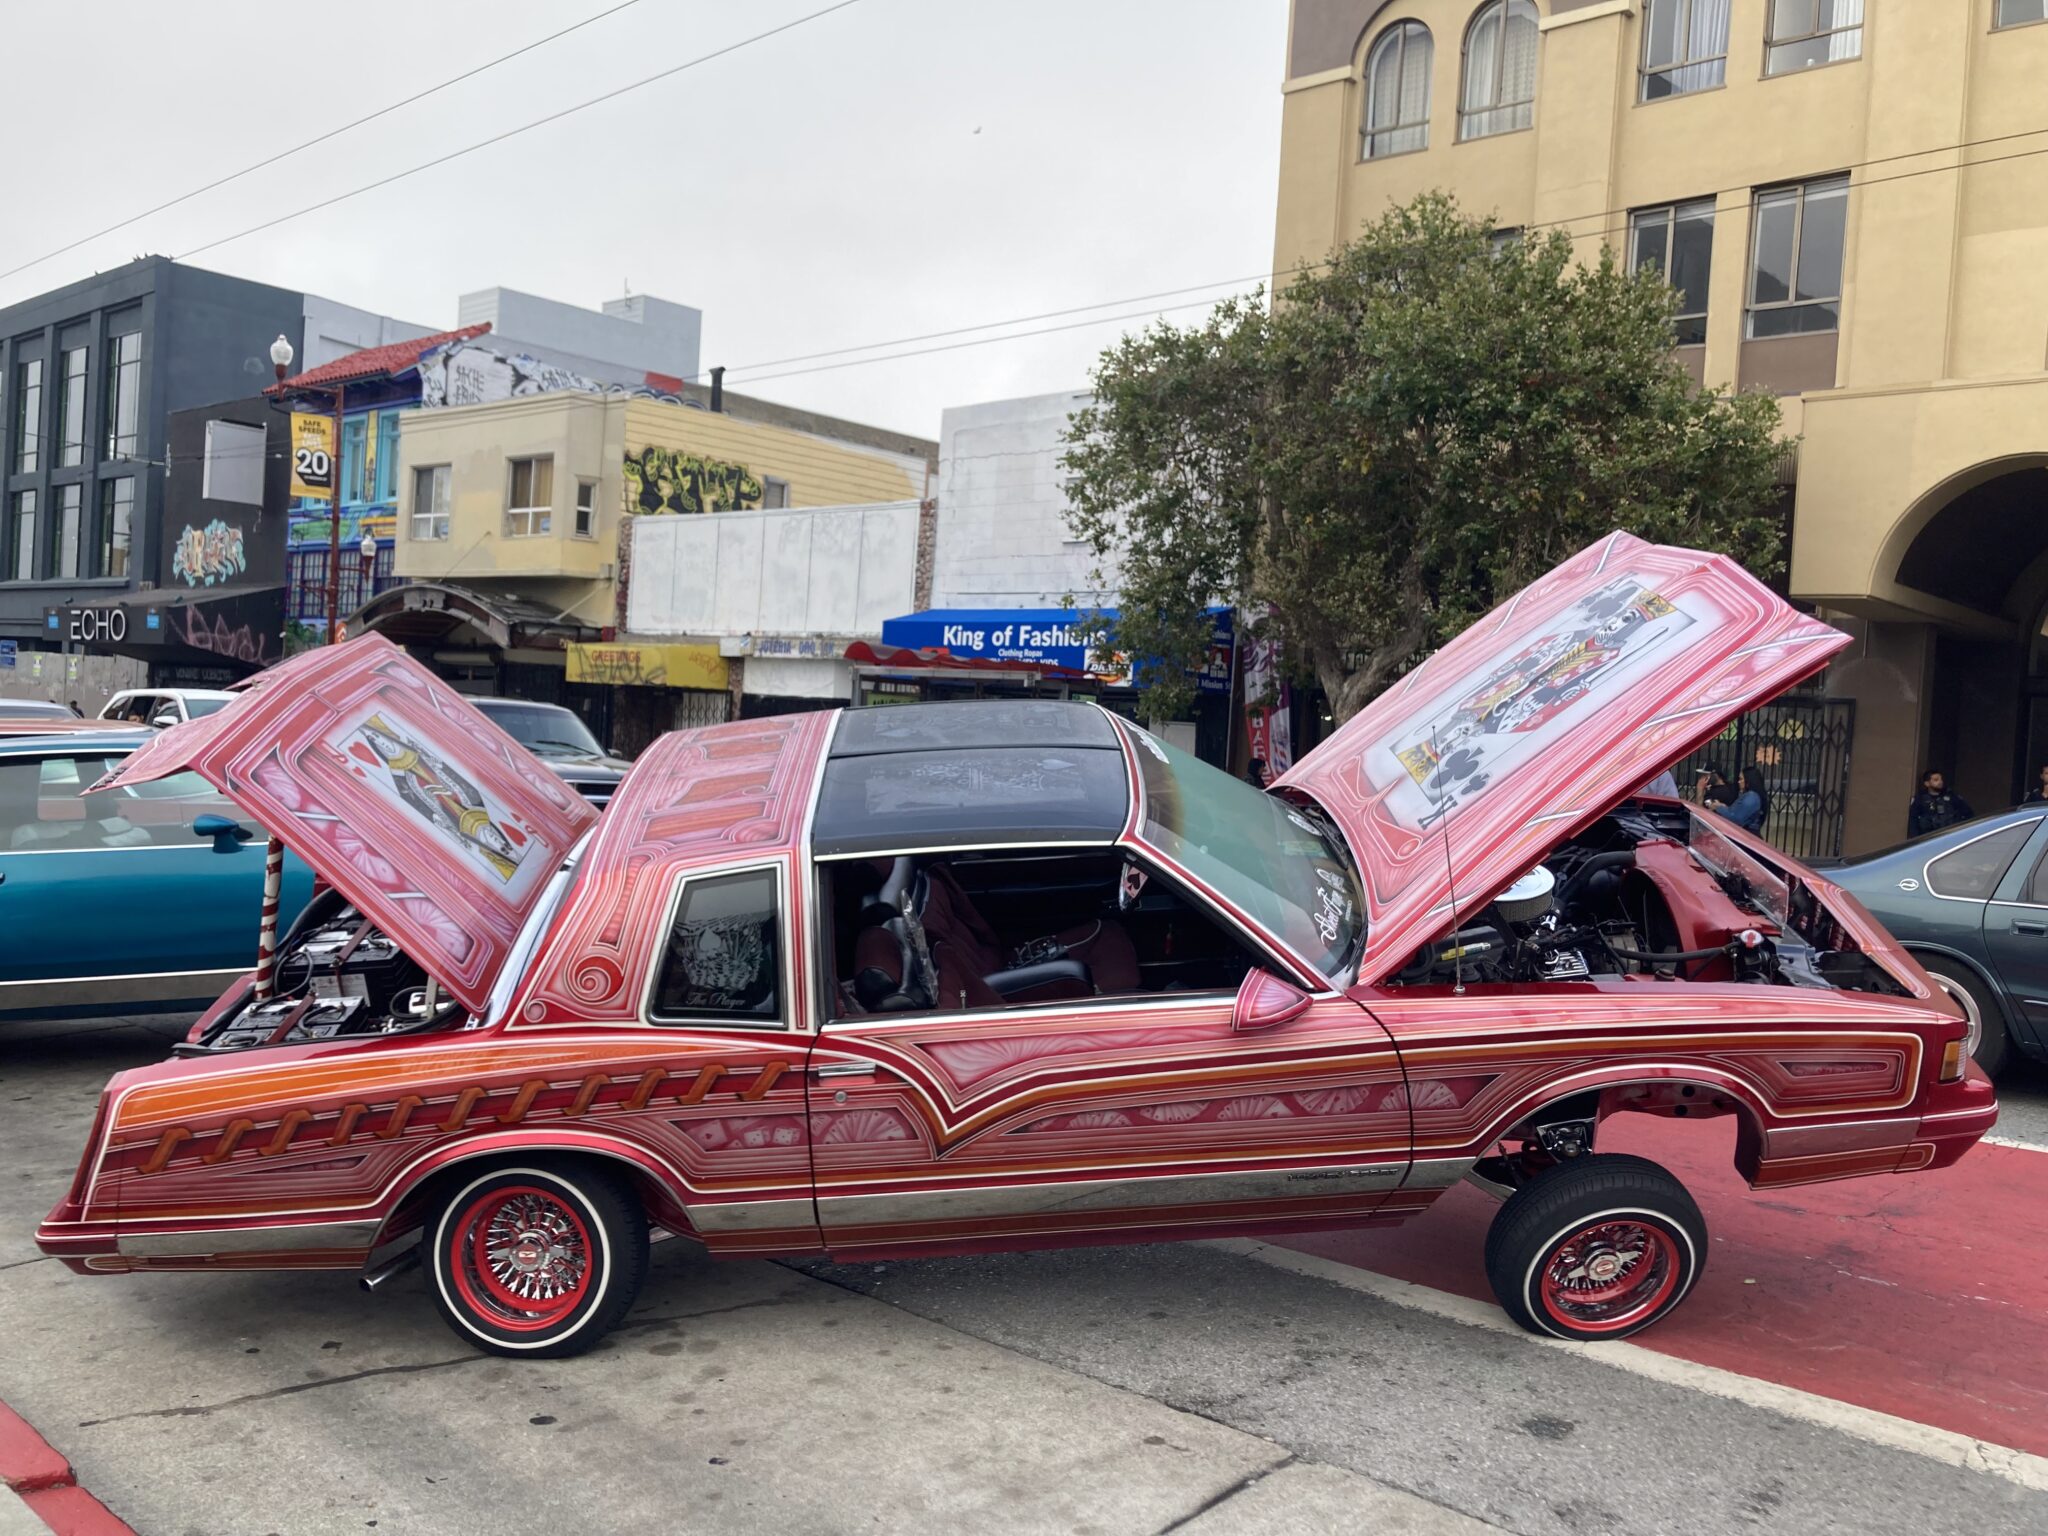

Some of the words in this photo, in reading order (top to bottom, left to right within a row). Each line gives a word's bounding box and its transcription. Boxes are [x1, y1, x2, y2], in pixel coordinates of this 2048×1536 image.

[296, 448, 329, 475] 20
[70, 609, 126, 641] ECHO
[943, 624, 984, 651] King
[991, 624, 1014, 647] of
[591, 650, 641, 662] GREETINGS
[998, 648, 1023, 658] Clothing
[1024, 649, 1043, 658] Ropas
